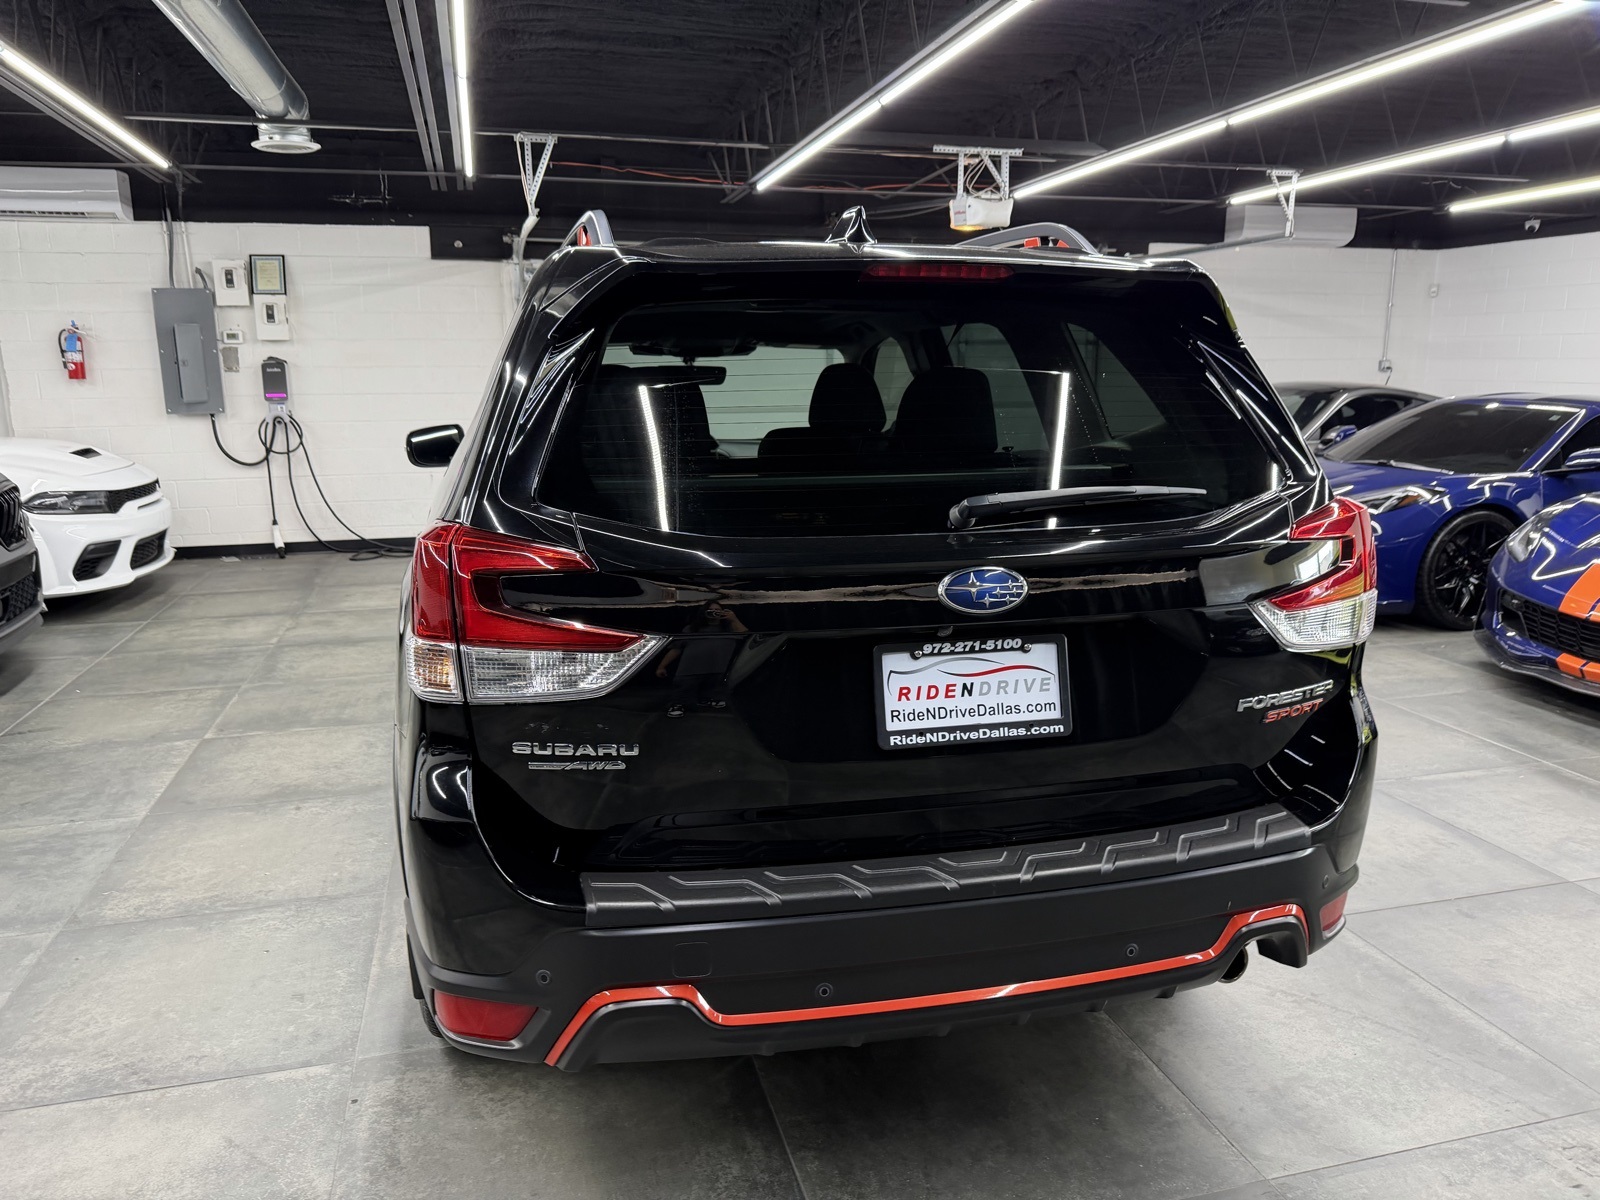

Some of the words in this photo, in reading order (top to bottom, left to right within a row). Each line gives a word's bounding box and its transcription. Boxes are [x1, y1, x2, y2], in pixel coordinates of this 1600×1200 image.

[922, 638, 1022, 654] 972-271-5100
[897, 677, 1052, 702] RIDENDRIVE
[1236, 679, 1334, 712] FORESTER
[890, 701, 1057, 723] RideNDriveDallas.com
[1264, 698, 1324, 723] SPORT
[889, 724, 1065, 746] RideNDriveDallas.com
[511, 741, 640, 756] SUBARU
[564, 760, 627, 771] AWD
